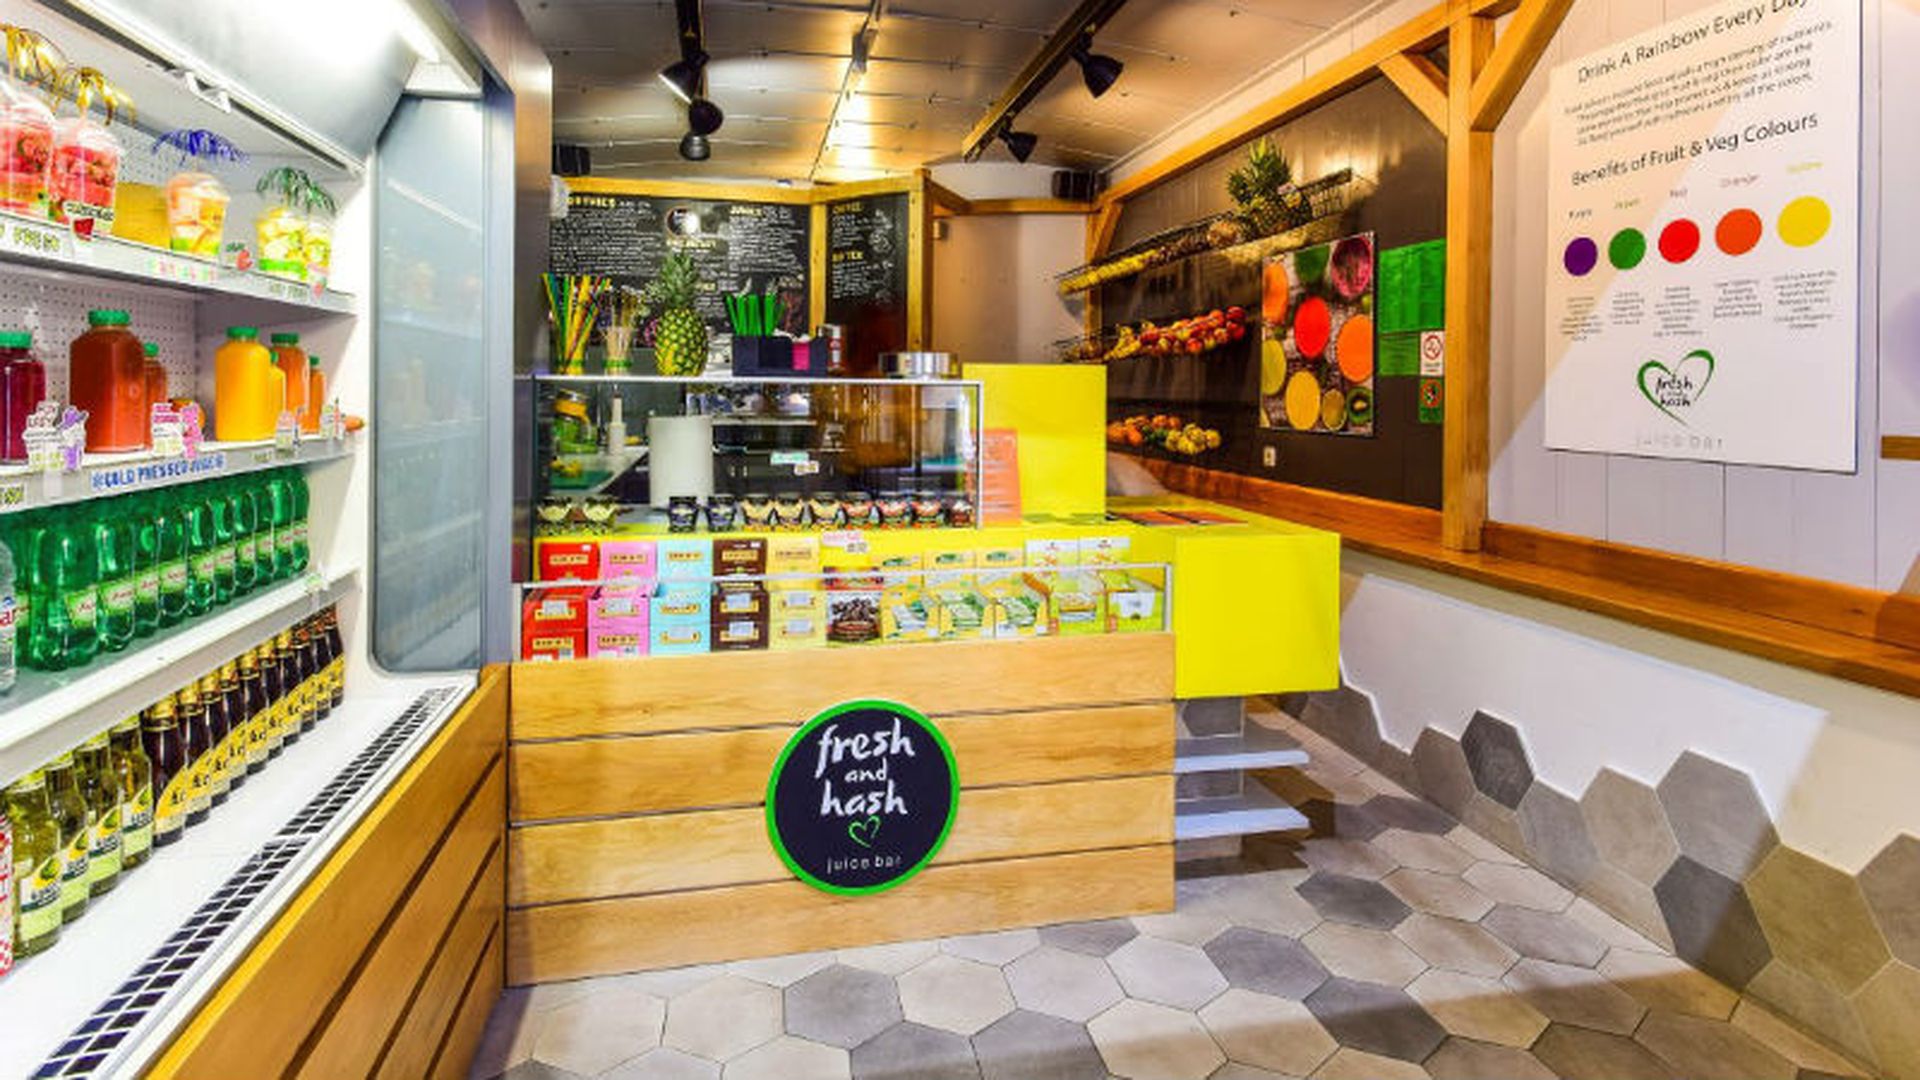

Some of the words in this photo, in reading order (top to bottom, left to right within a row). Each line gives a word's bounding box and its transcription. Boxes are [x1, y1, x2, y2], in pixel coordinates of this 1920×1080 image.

[1577, 57, 1617, 83] Drink
[1619, 51, 1632, 68] A
[1636, 24, 1709, 62] Rainbow
[1713, 2, 1766, 34] Every
[1571, 160, 1629, 186] Benefits
[1631, 153, 1647, 171] of
[1650, 142, 1685, 166] Fruit
[1689, 140, 1703, 158] &
[1705, 131, 1739, 153] Veg
[1744, 113, 1818, 143] Colours
[815, 716, 915, 779] fresh
[845, 756, 888, 782] and
[820, 779, 908, 817] hash
[827, 856, 871, 875] juice
[874, 855, 902, 868] bar
